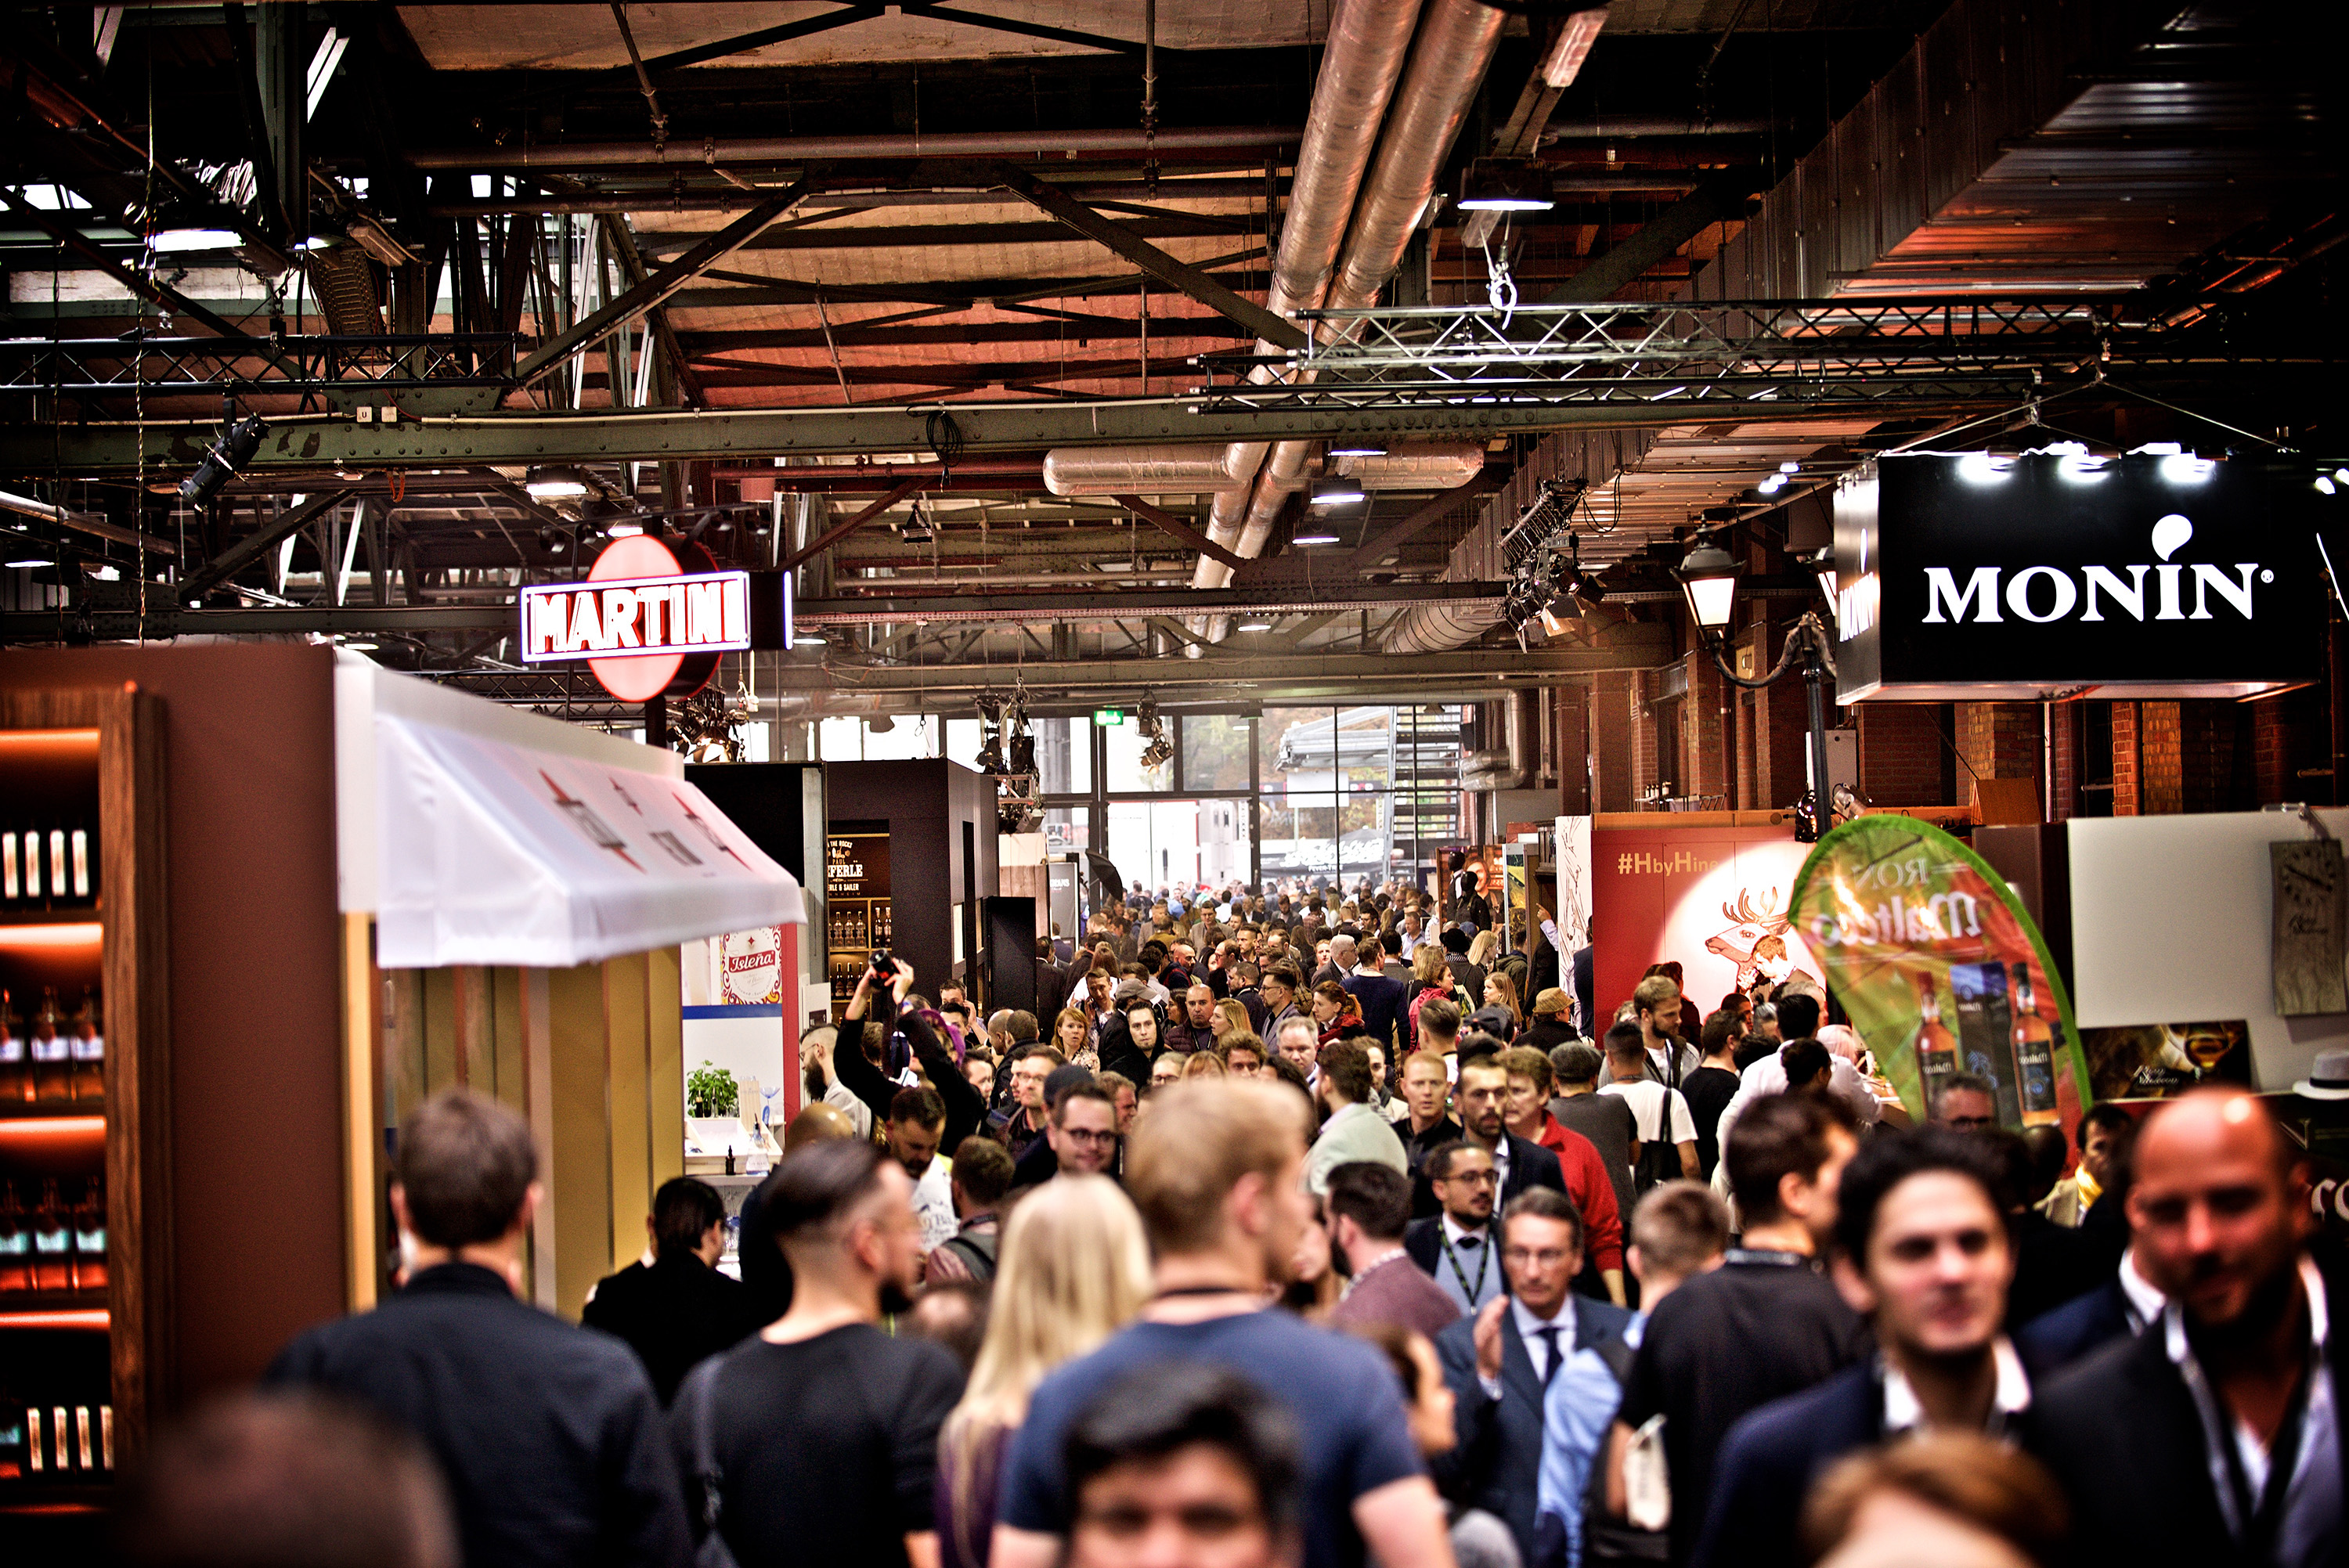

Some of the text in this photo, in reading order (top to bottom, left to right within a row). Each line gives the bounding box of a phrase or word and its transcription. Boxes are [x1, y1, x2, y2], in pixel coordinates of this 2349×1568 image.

[532, 581, 747, 654] MARTINI
[1618, 852, 1719, 877] #HbyHine
[730, 953, 774, 973] Isleña
